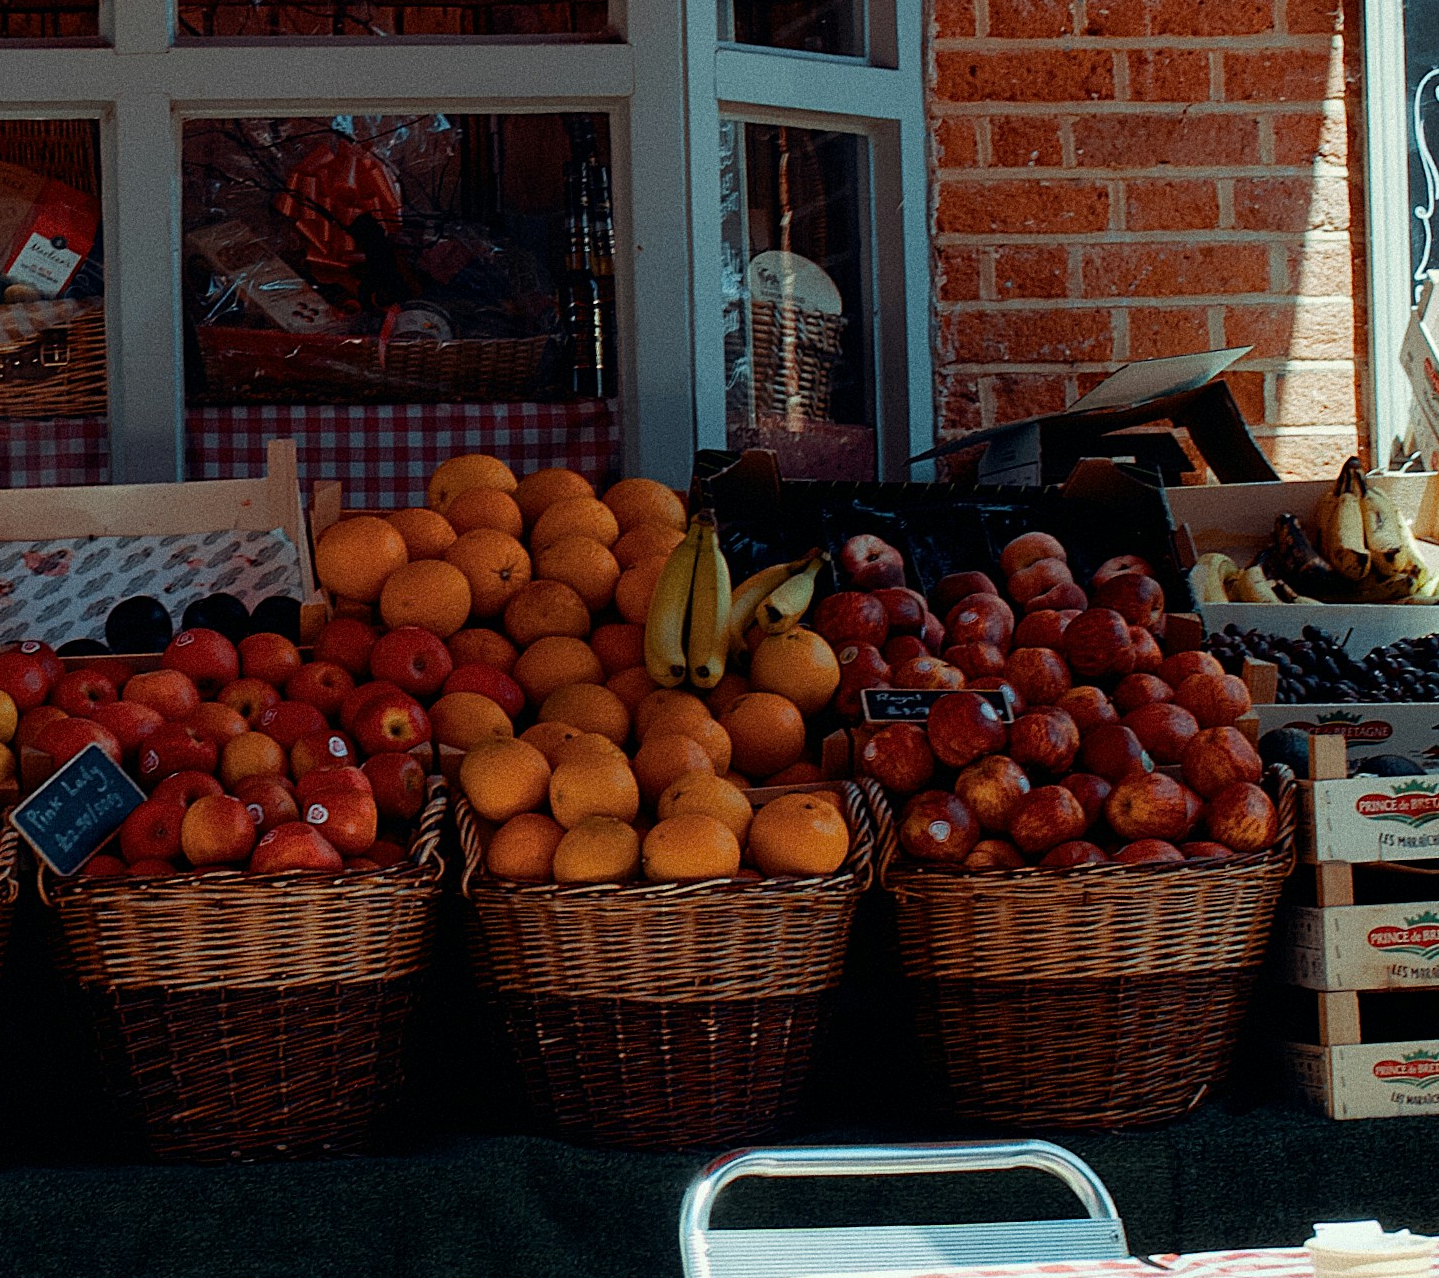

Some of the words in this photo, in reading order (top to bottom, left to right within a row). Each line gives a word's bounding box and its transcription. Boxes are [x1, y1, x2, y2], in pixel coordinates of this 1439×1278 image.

[25, 795, 64, 833] Pink
[59, 764, 108, 797] Lady
[1358, 798, 1398, 813] PRINCE
[1398, 799, 1410, 810] de
[1379, 831, 1396, 845] LES
[1370, 930, 1411, 945] PRINCE
[1411, 931, 1422, 942] de
[1391, 963, 1408, 978] LES
[1375, 1063, 1409, 1076] PRINCE
